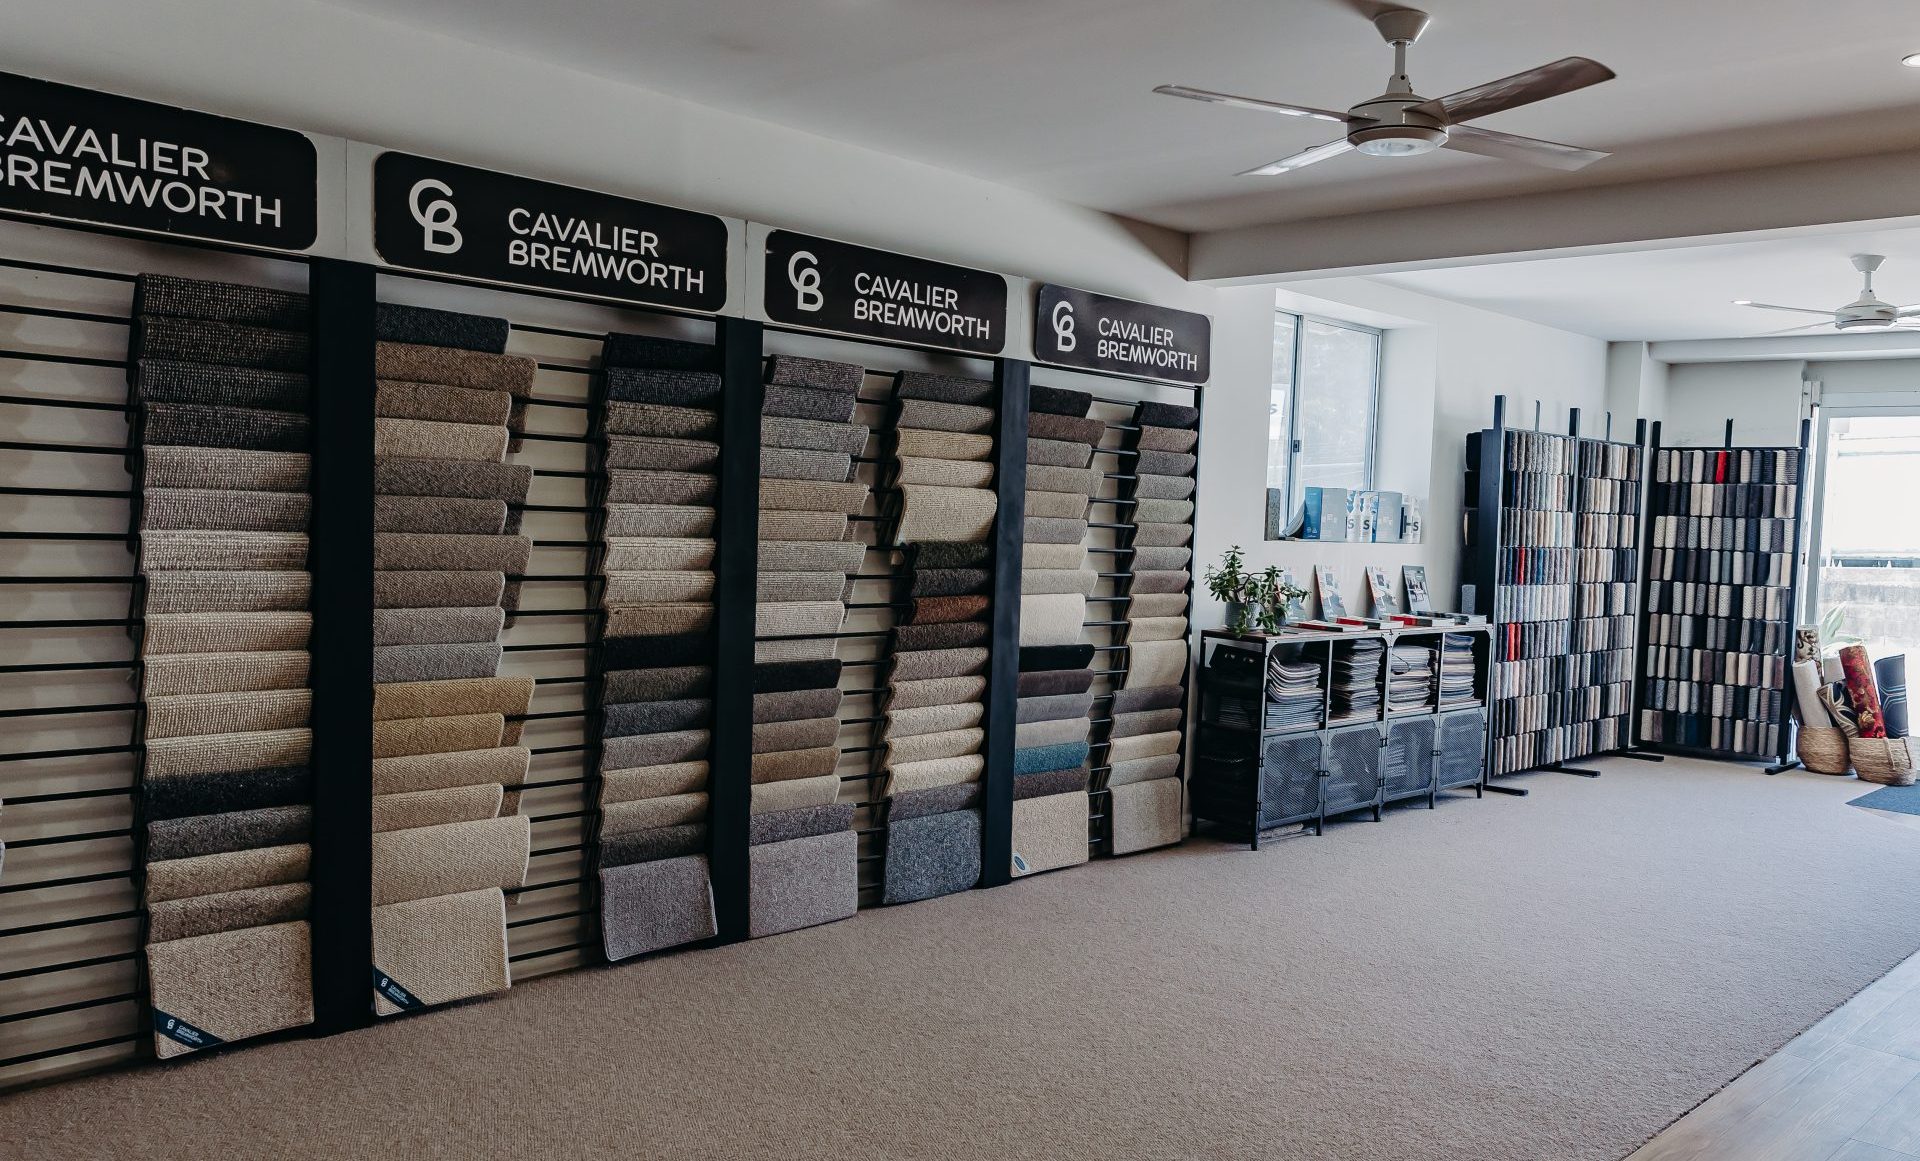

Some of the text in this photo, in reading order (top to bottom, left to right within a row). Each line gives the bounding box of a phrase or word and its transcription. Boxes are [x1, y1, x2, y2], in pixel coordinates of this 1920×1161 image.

[0, 115, 210, 181] AVALIER
[0, 153, 281, 228] REMWORTH
[508, 207, 659, 258] CAVALIER
[508, 239, 704, 294] BREMWORTH
[854, 272, 958, 311] CAVALIER
[854, 298, 990, 340] BREMWORTH
[1098, 317, 1174, 348] CAVALIER
[1097, 339, 1198, 372] BREMWORTH
[1363, 519, 1370, 530] S
